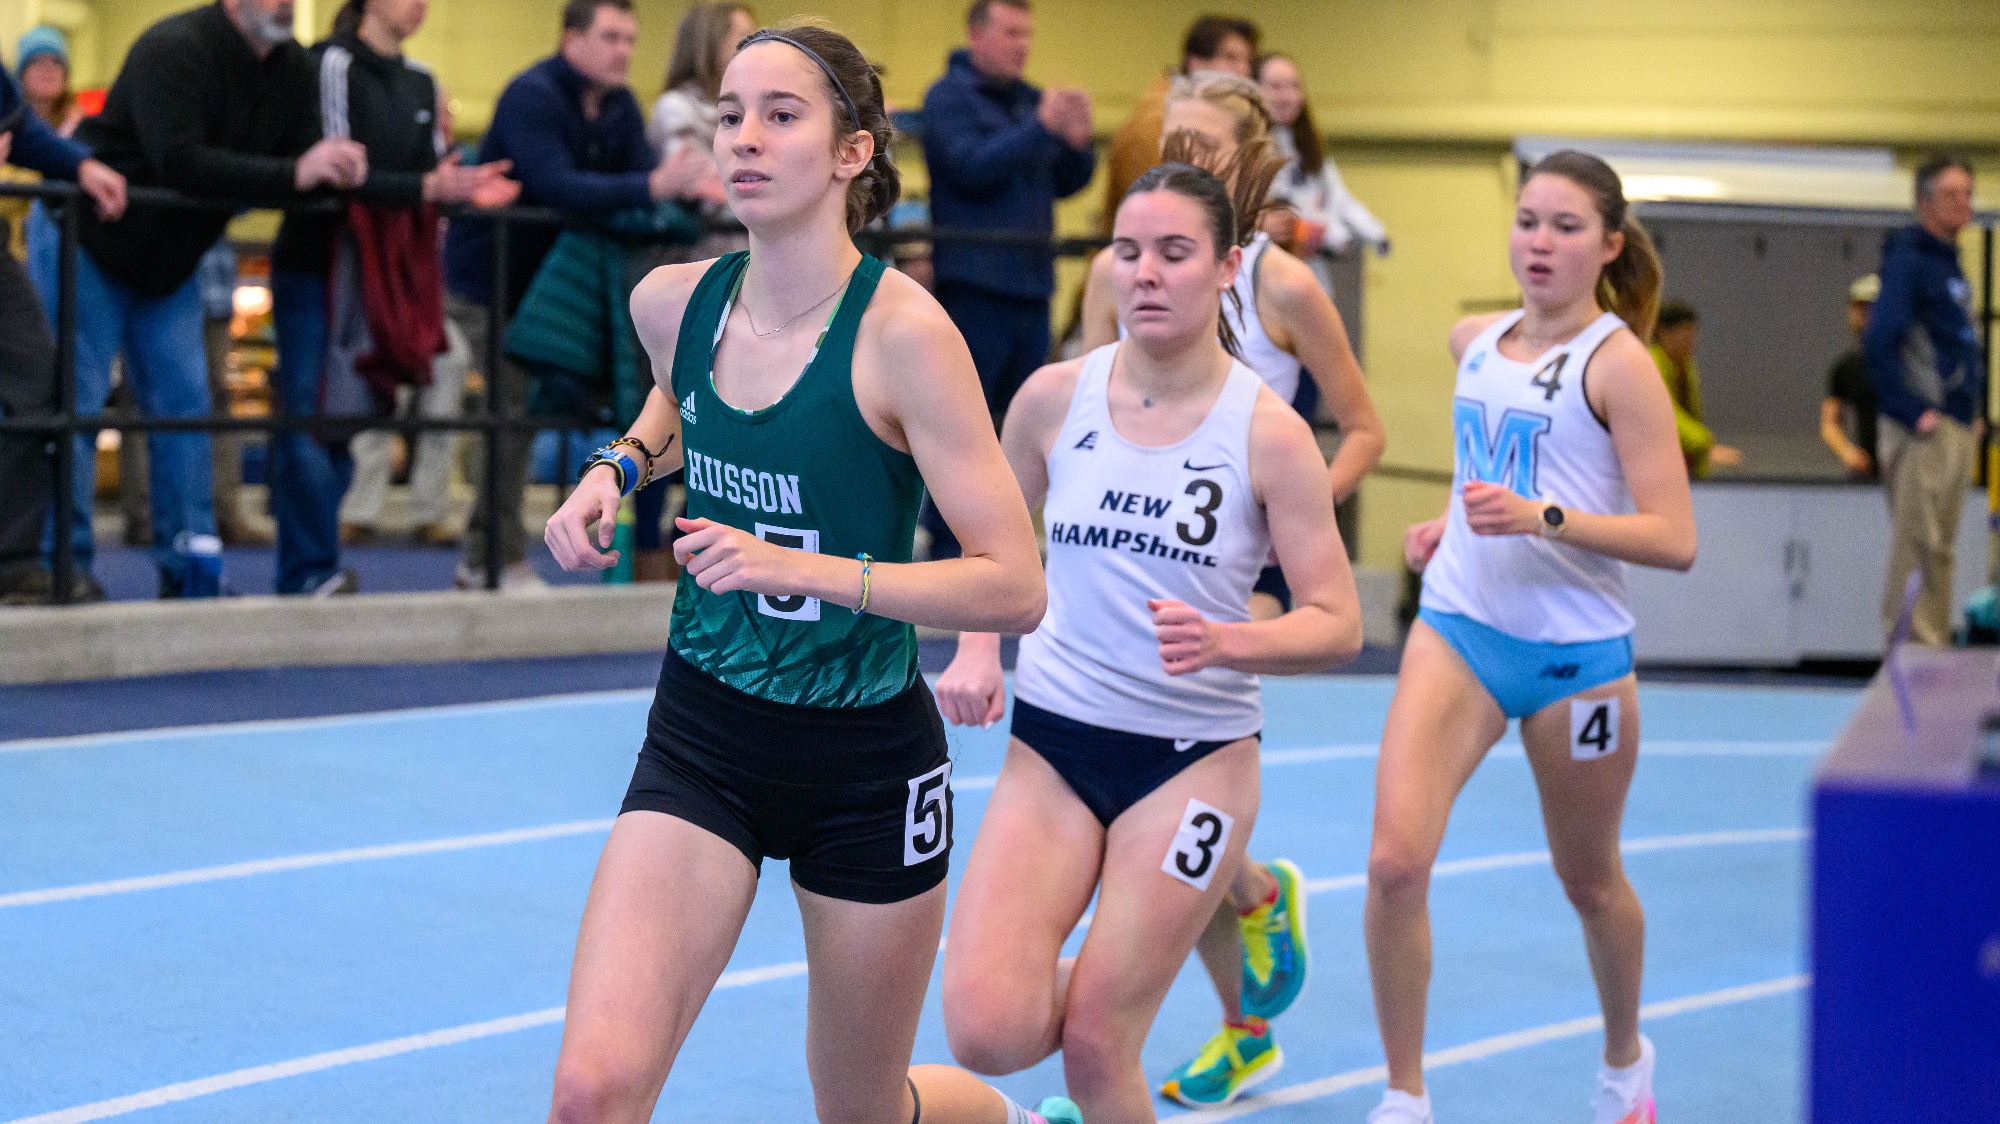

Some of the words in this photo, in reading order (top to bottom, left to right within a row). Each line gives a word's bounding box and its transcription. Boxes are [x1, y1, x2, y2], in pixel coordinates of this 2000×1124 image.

[1530, 352, 1569, 400] 4
[687, 447, 802, 514] HUSSON
[1453, 396, 1552, 498] M
[1099, 490, 1172, 519] NEW
[1176, 478, 1223, 546] 3
[1577, 704, 1612, 752] 4
[912, 770, 944, 854] 5
[1175, 811, 1224, 879] 3
